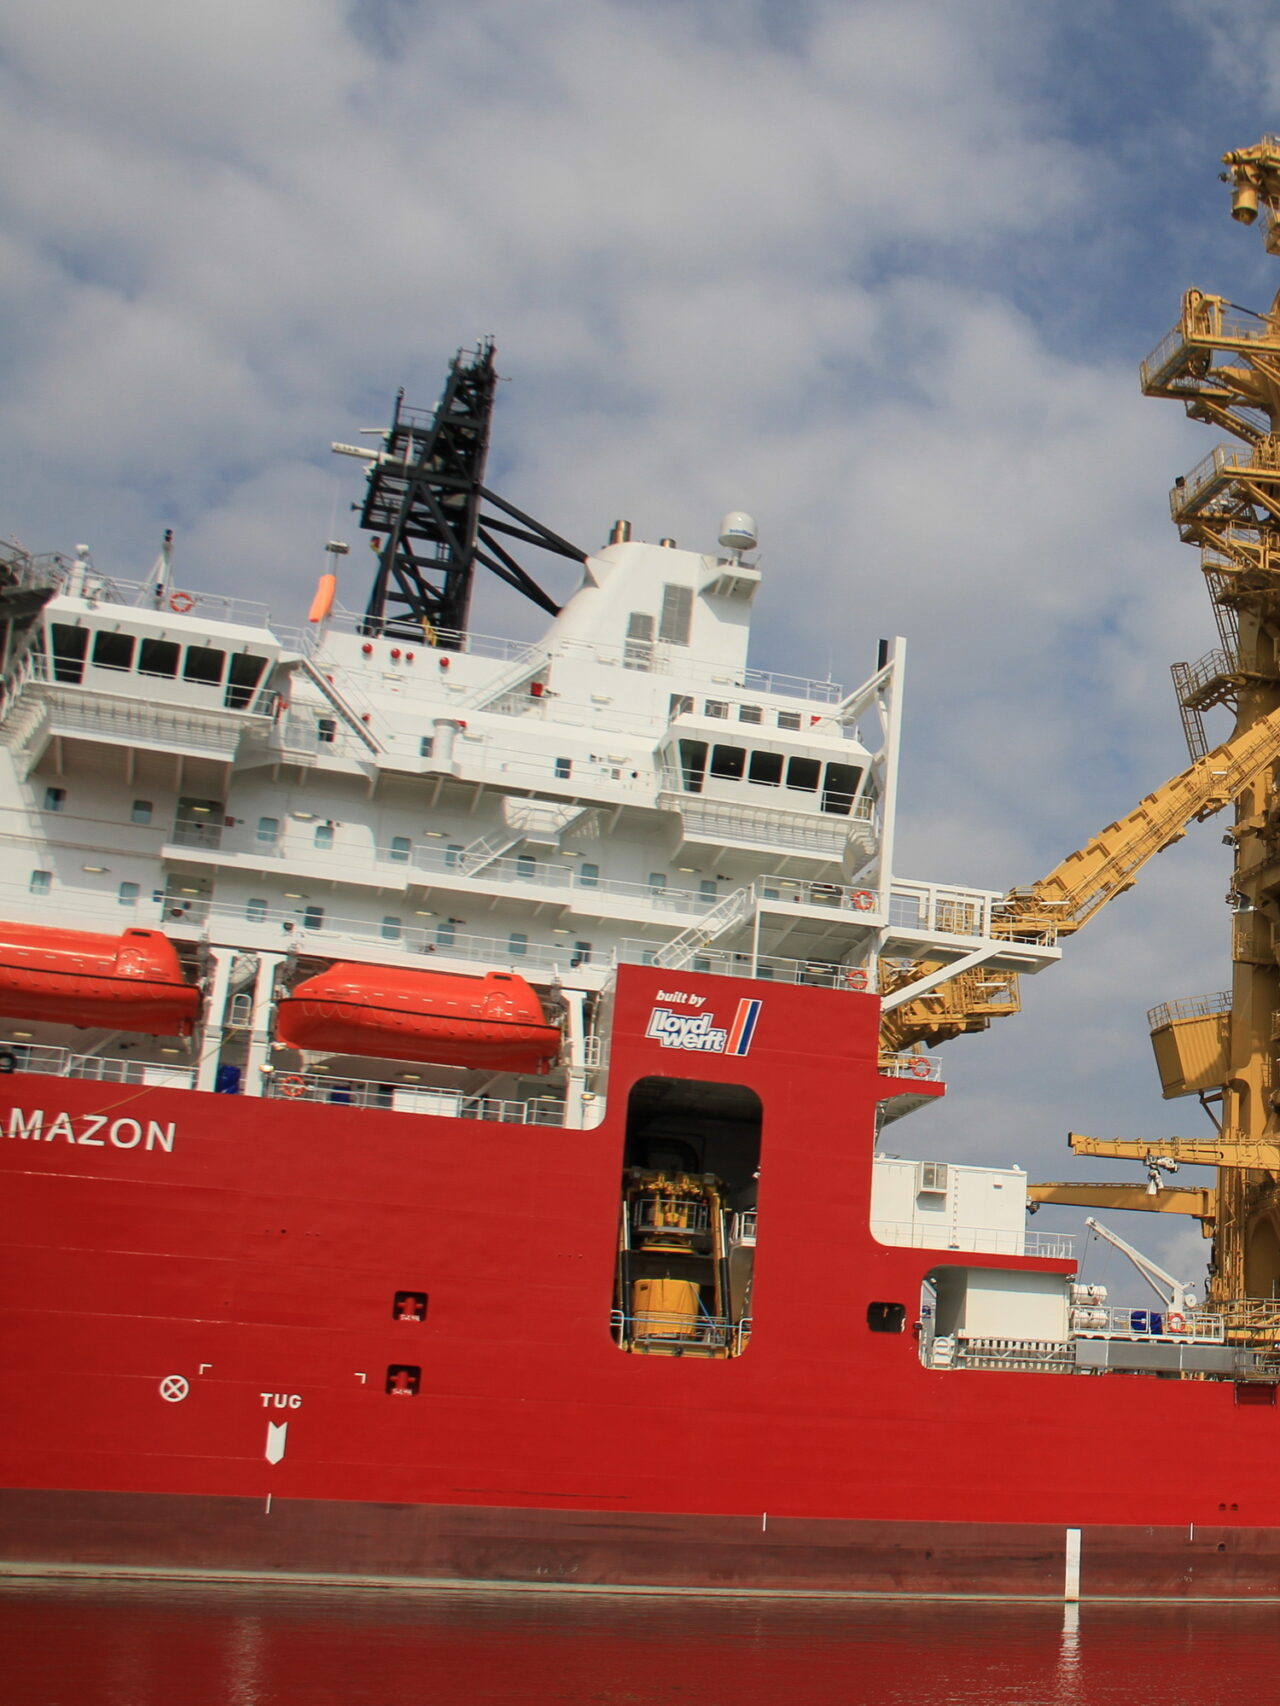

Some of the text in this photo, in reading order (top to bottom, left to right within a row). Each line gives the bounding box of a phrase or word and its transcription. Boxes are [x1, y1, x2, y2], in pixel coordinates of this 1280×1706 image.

[656, 989, 707, 1008] built by
[662, 1029, 727, 1053] werft
[0, 1107, 176, 1152] MAZON
[260, 1392, 302, 1409] TUG
